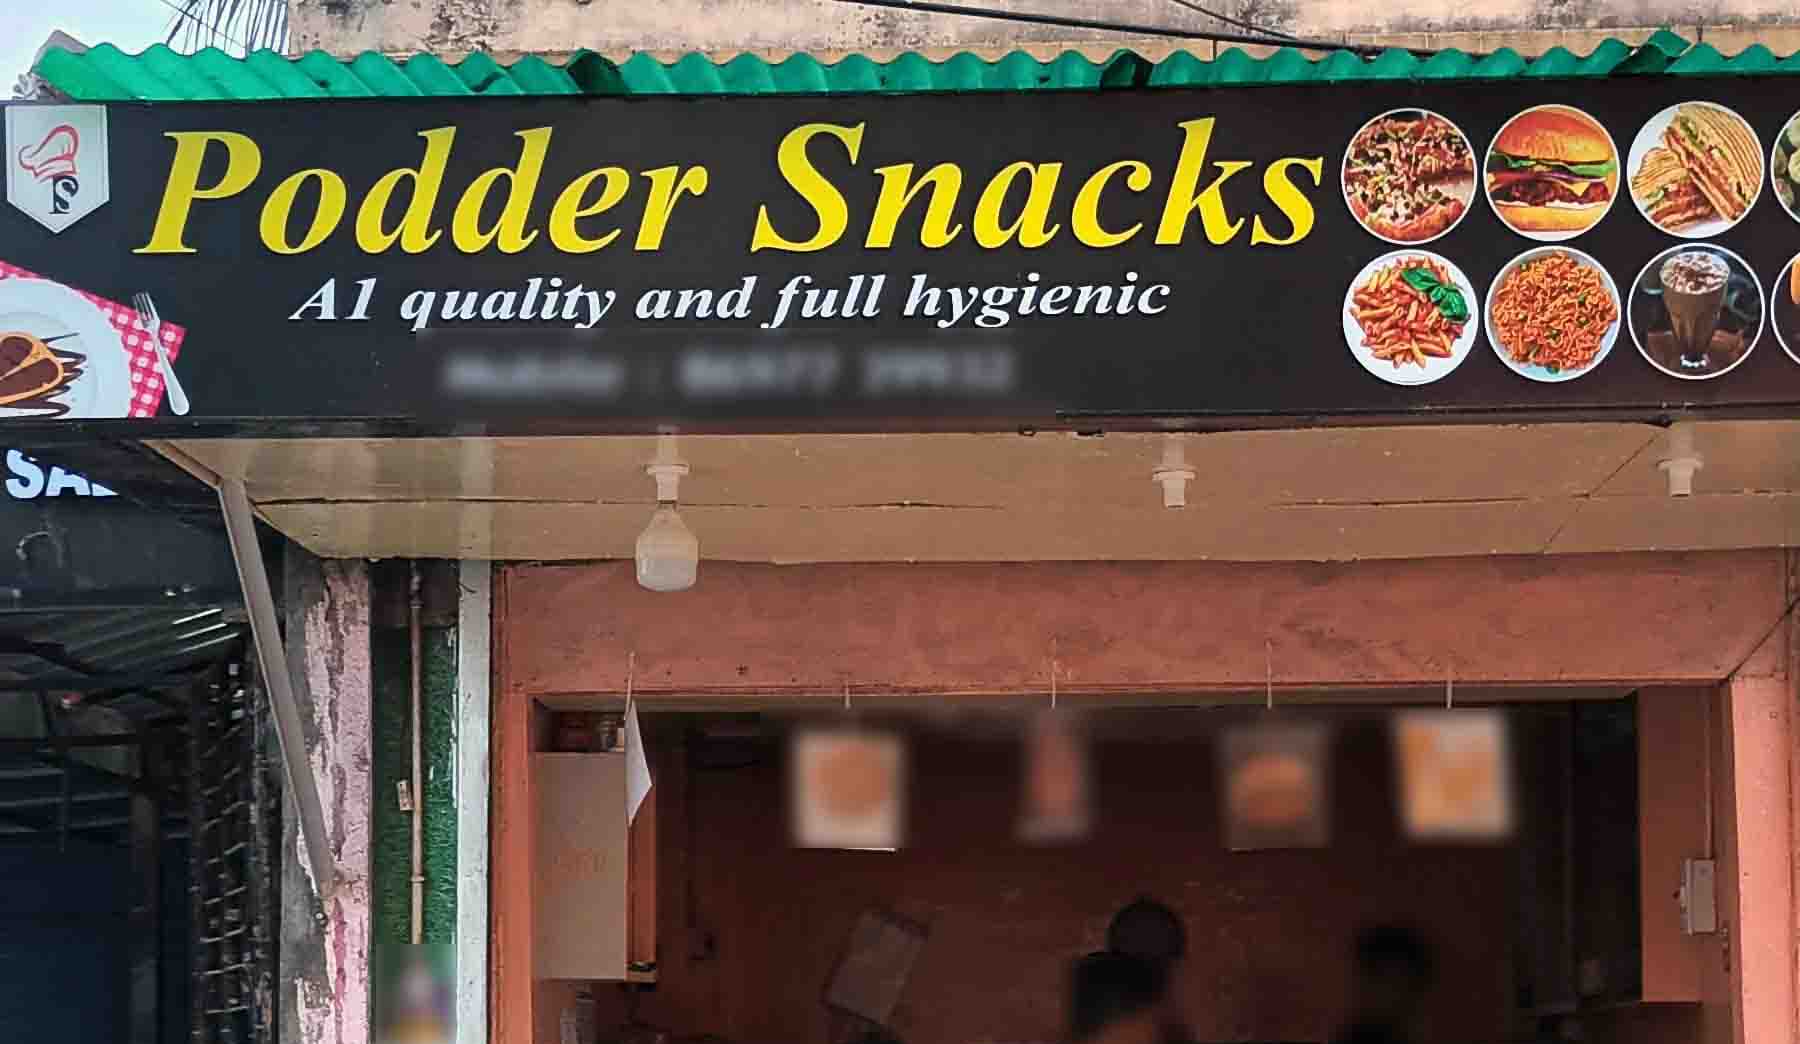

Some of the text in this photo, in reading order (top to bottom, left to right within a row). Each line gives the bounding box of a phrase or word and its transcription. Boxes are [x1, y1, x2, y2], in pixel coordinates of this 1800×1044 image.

[132, 116, 1324, 256] Podder Snacks
[288, 271, 1171, 331] A1 quality and full hygienic
